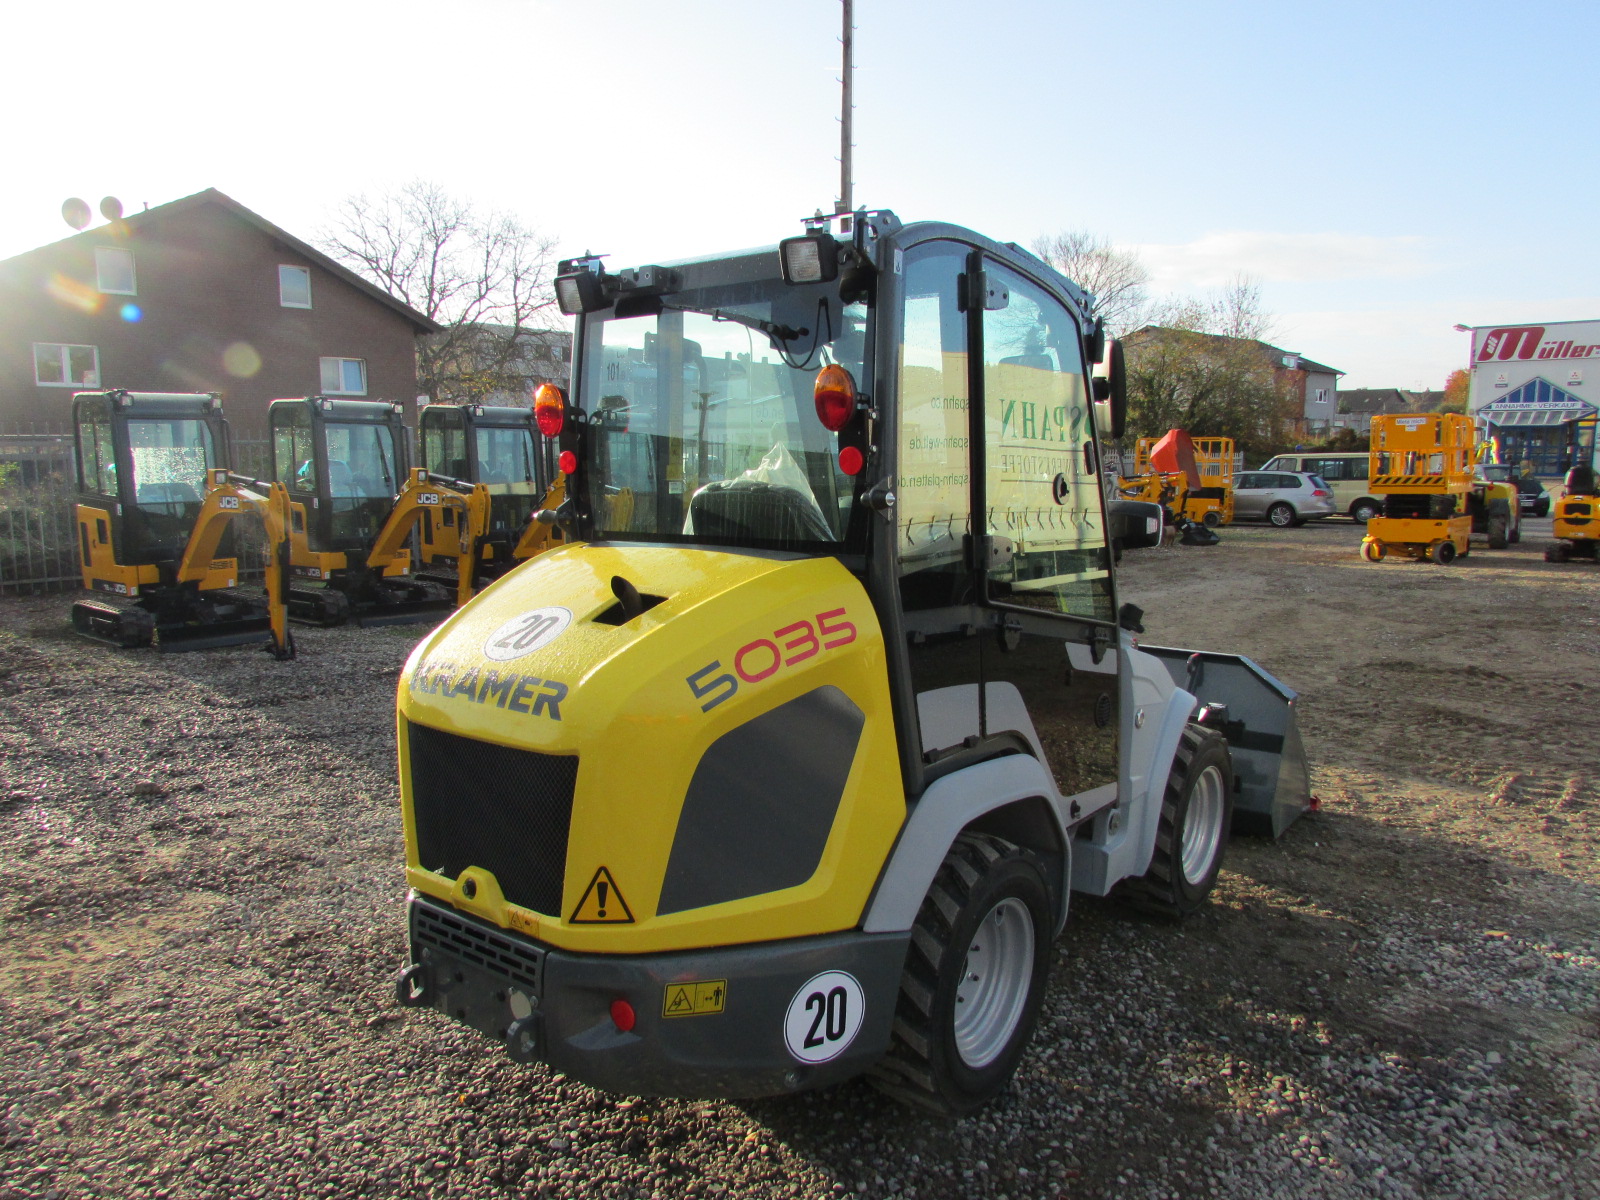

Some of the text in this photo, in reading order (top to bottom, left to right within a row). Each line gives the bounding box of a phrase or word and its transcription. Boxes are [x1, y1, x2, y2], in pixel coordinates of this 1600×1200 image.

[219, 496, 239, 509] JCB
[417, 493, 439, 505] JCB
[493, 613, 560, 650] 20
[685, 606, 858, 713] 5035
[410, 659, 569, 721] KRAMER
[803, 986, 848, 1051] 20
